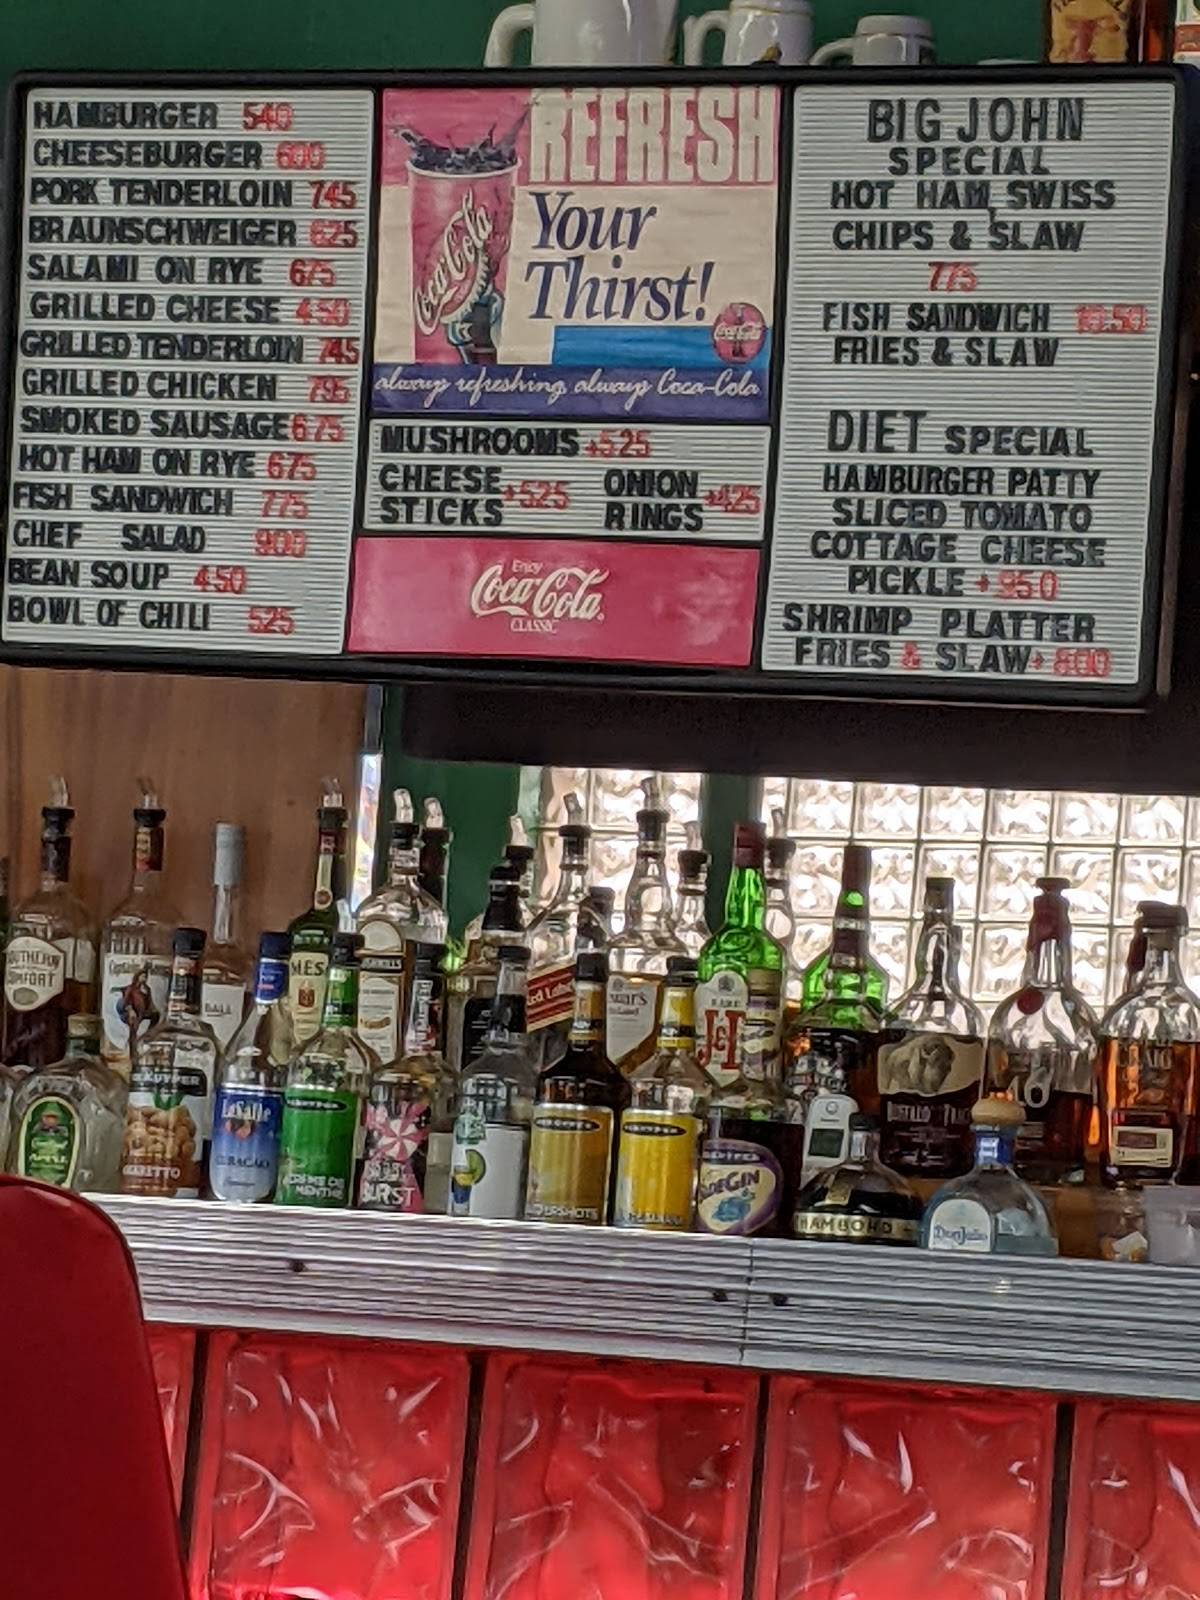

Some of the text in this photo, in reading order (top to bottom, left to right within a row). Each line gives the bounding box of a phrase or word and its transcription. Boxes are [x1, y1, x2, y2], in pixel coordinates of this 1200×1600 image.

[33, 102, 218, 129] HAMBURGER
[867, 98, 1085, 143] BIG JOHN
[529, 87, 777, 184] REFRESH
[33, 139, 263, 169] CHEESEBURGER
[888, 146, 1050, 175] SPECIAL
[29, 177, 357, 209] PORK TENDERLOIN 745
[829, 180, 896, 210] HOT
[1006, 179, 1116, 209] SWISS
[28, 216, 297, 245] BRAUNSCHWEIGER
[527, 191, 657, 251] Your
[832, 221, 1086, 252] CHIPS & SLAW
[27, 255, 139, 282] SALAMI
[155, 257, 195, 284] ON
[207, 258, 263, 285] RYE
[524, 255, 715, 322] Thirst!
[30, 292, 155, 321] GRILLED
[166, 294, 281, 323] CHEESE
[822, 302, 891, 331] FISH
[906, 303, 1050, 333] SANDWICH
[20, 330, 131, 358] GRILLED
[137, 333, 304, 363] TENDERLOIN
[833, 336, 1059, 367] FRIES & SLAW
[22, 369, 139, 396] GRILLED
[147, 372, 278, 399] CHICKEN
[455, 366, 567, 407] refreshing
[574, 368, 652, 411] always
[657, 367, 760, 397] Coca-Cola
[21, 406, 344, 442] SMOKED SAUSAGE 675
[827, 410, 1094, 457] DIET SPECIAL
[380, 426, 579, 456] MUSHROOMS
[19, 445, 317, 480] HOT HAM ON RYE 675
[379, 464, 501, 493] CHEESE
[604, 469, 699, 499] ONION
[823, 465, 1101, 498] HAMBURGER PATTY
[13, 482, 309, 518] FISH SANDWICH 775
[380, 497, 504, 527] STICKS
[832, 497, 1093, 532] SLICED TOMATO
[605, 502, 703, 531] RINGS
[13, 520, 84, 548] CHEF
[121, 524, 206, 551] SALAD
[810, 531, 1107, 567] COTTAGE CHEESE
[8, 559, 247, 594] BEAN SOUP 450
[512, 559, 543, 575] Enjoy
[847, 565, 966, 597] PICKLE
[6, 597, 295, 635] BOWL OF CHILI 525
[782, 603, 1096, 642] SHRIMP PLATTER
[795, 637, 891, 669] FRIES
[901, 641, 921, 670] &
[936, 643, 1033, 674] SLAW
[796, 1213, 894, 1234] HAMBORD
